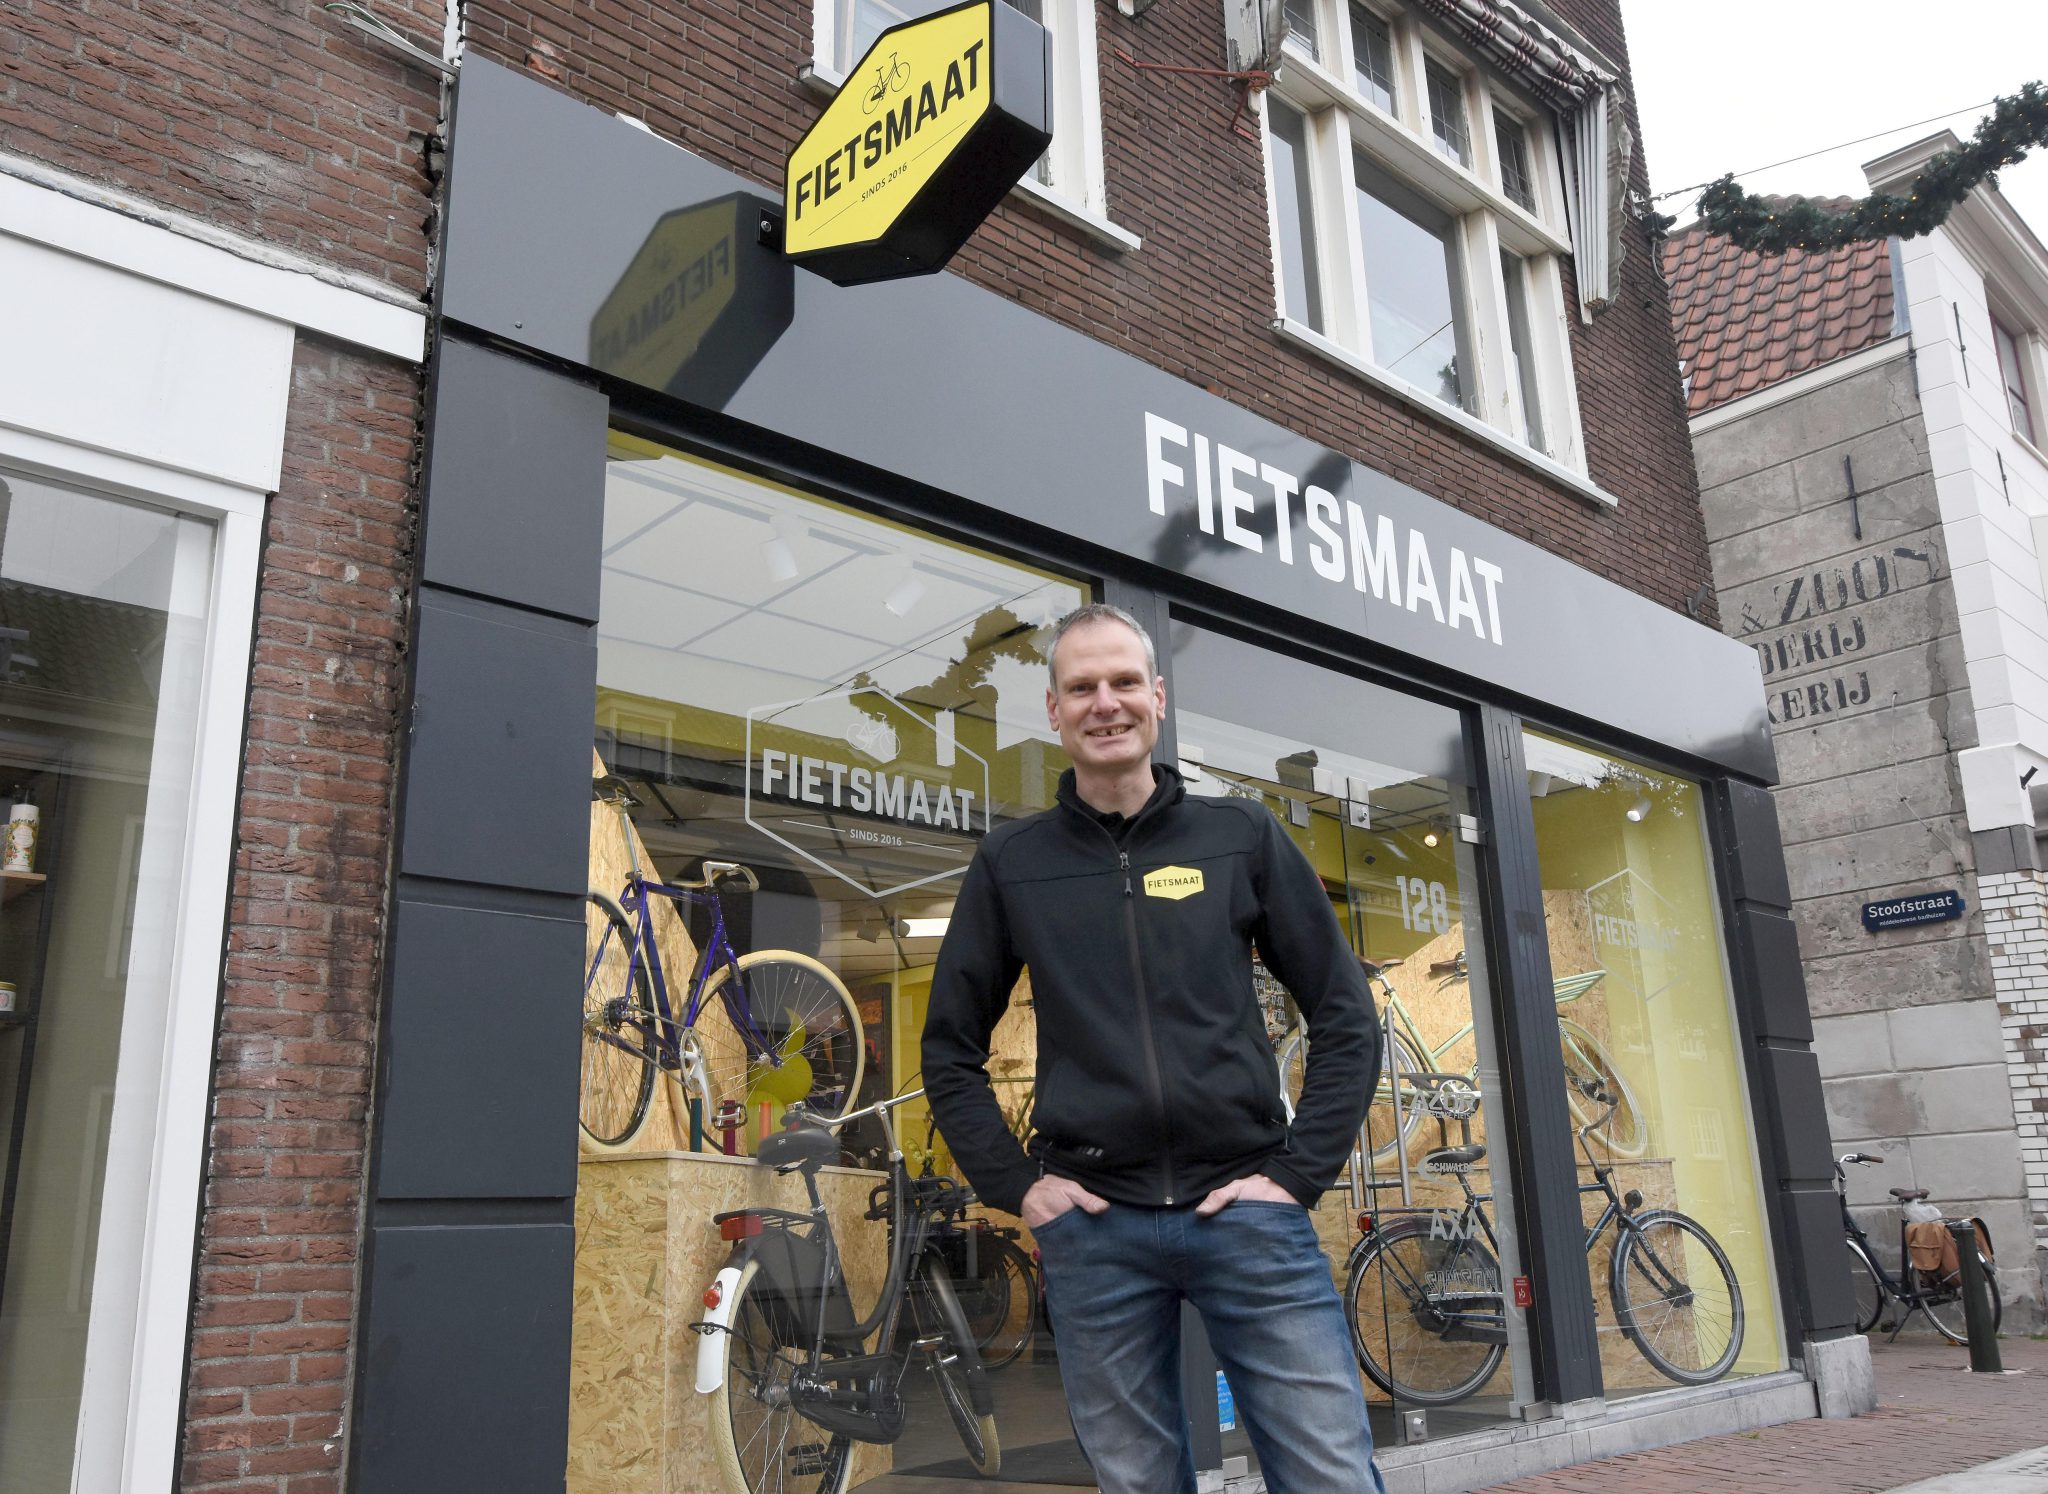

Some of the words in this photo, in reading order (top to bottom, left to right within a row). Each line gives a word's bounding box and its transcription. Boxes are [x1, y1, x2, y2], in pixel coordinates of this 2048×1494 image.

[795, 38, 984, 221] FIETSMAAT
[861, 178, 886, 202] SINDS
[888, 162, 908, 184] 2016
[1144, 411, 1503, 646] FIETSMAAT
[762, 748, 975, 832] FIETSMAAT
[850, 828, 879, 843] SINDS
[880, 834, 902, 846] 2016
[1147, 876, 1200, 889] FIETSMAAT
[1396, 875, 1450, 936] 128
[1868, 895, 1953, 918] Stoofstraat
[1595, 912, 1680, 952] FIETS
[1410, 1090, 1476, 1112] AZOR
[1430, 1207, 1484, 1241] AXA
[1425, 1266, 1498, 1302] SIMSON
